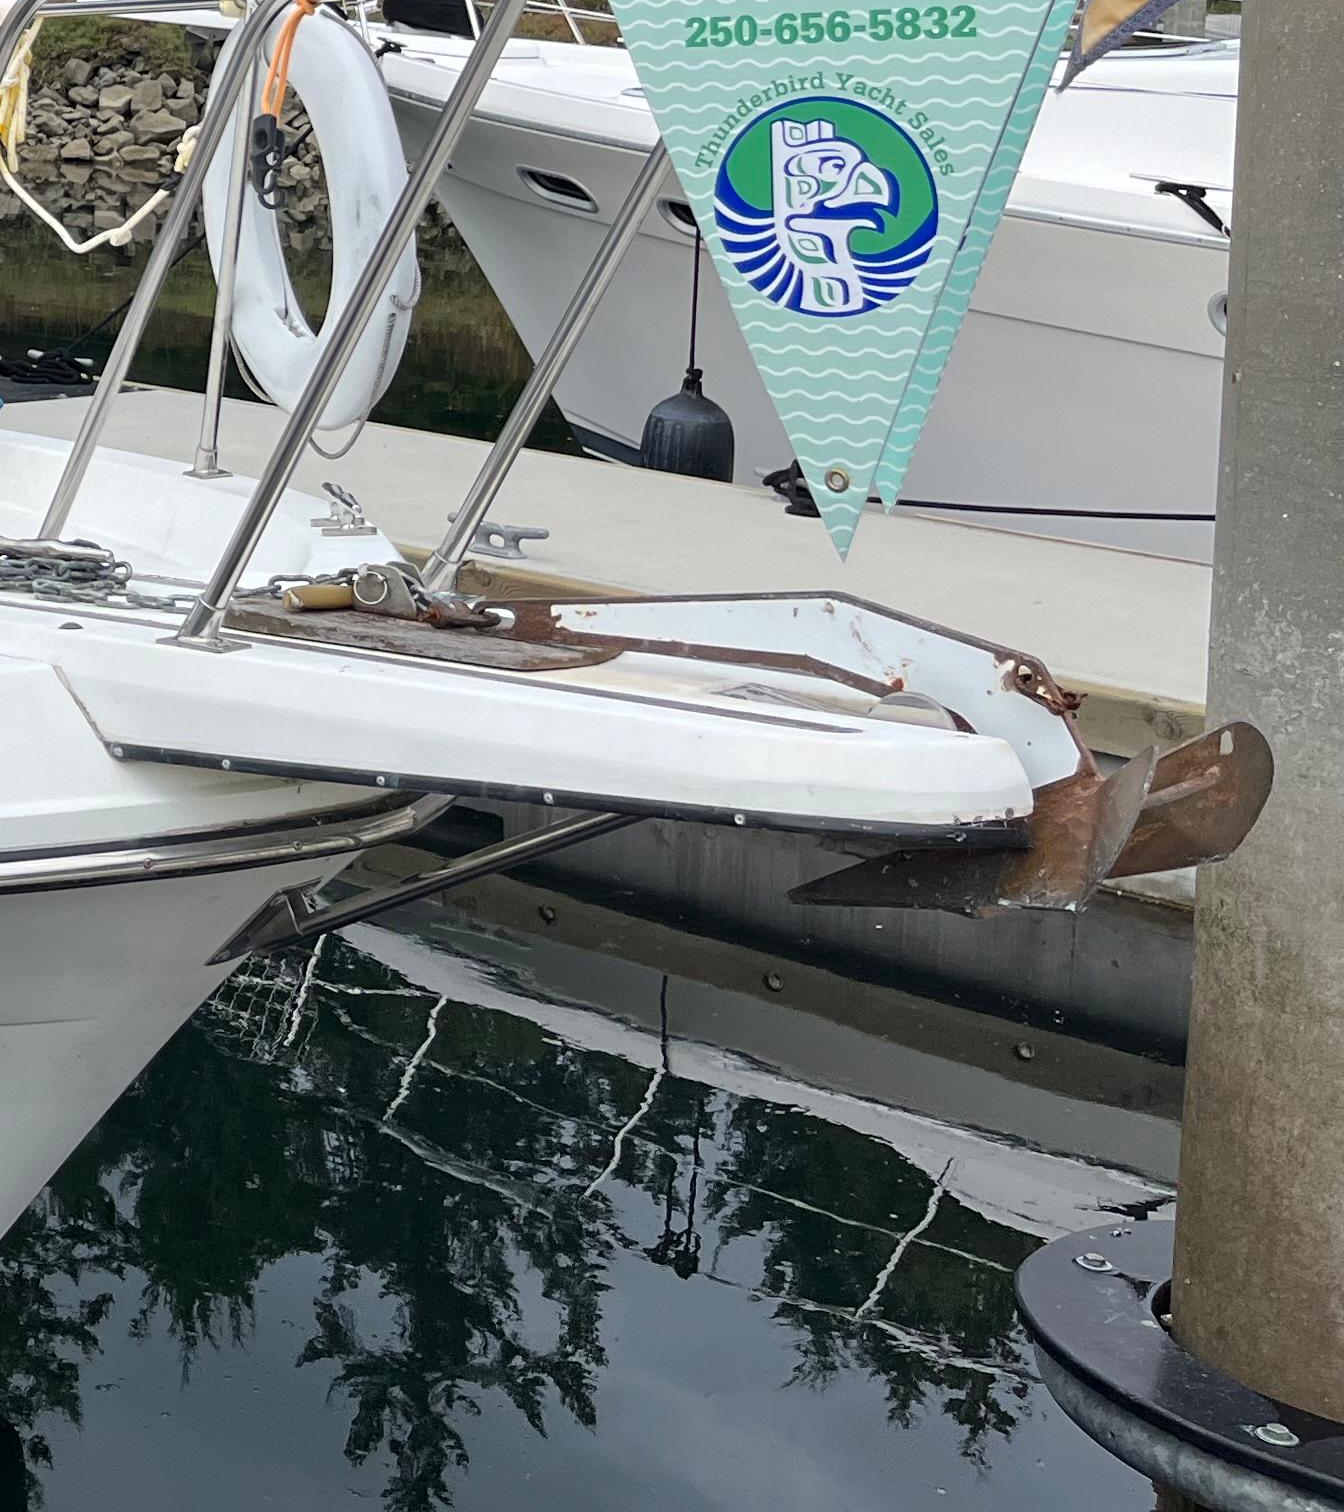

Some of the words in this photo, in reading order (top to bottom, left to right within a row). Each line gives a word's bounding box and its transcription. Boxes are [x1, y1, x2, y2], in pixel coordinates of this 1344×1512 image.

[684, 5, 978, 48] 250-656-5832
[695, 72, 825, 169] Thunderbird
[835, 72, 910, 116] Yacht
[908, 111, 955, 177] Sales
